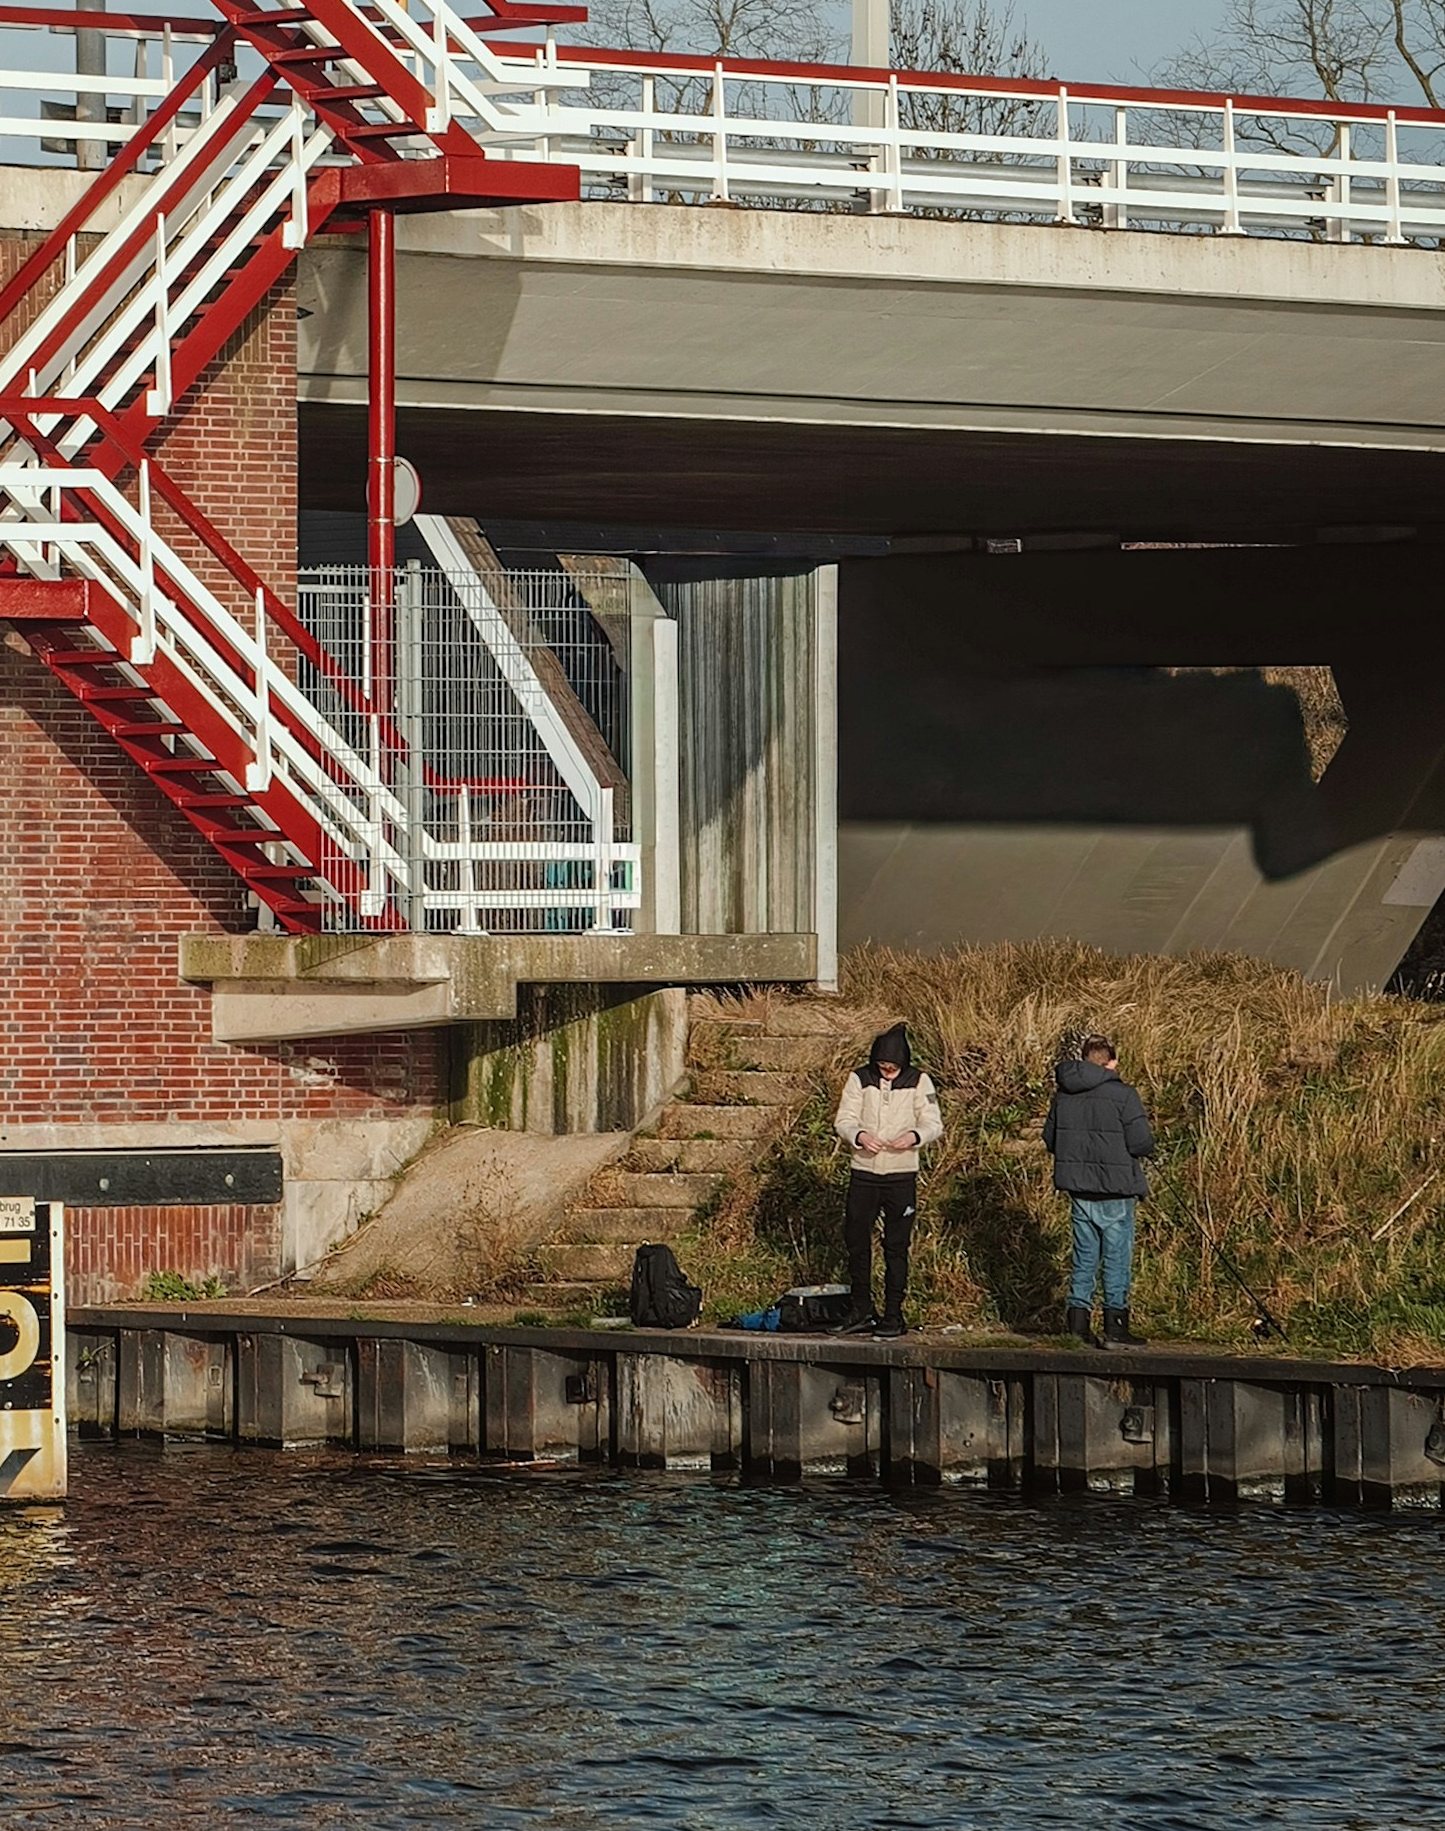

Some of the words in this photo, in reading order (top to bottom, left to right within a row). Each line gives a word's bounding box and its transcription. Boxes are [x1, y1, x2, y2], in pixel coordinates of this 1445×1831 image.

[0, 1201, 21, 1214] brug
[4, 1217, 15, 1228] 71
[18, 1216, 31, 1228] 35
